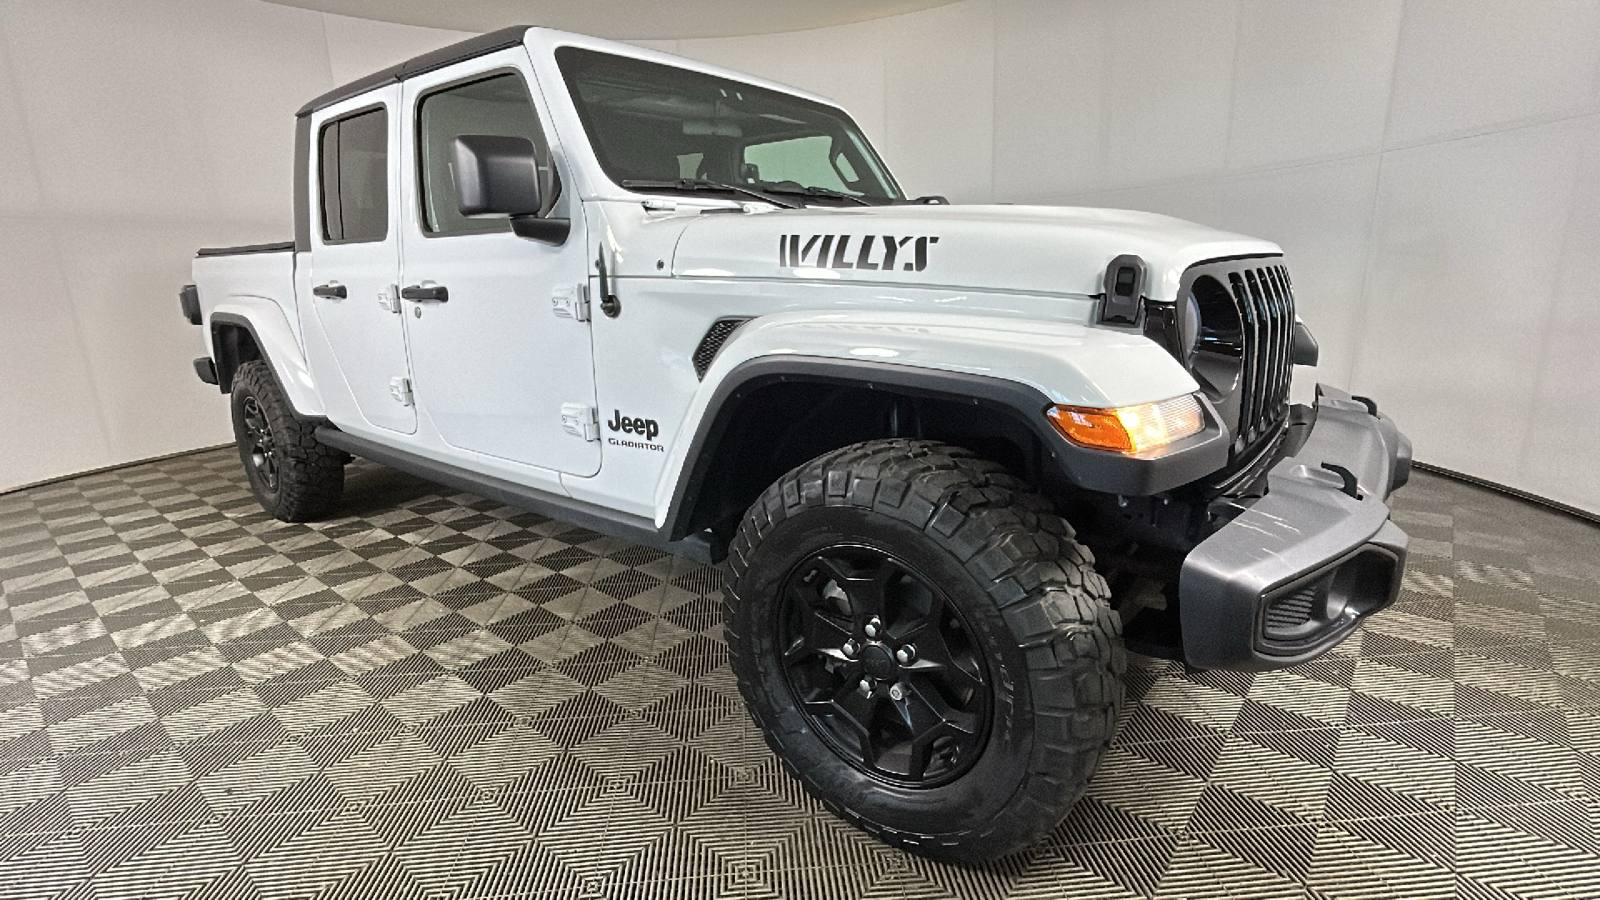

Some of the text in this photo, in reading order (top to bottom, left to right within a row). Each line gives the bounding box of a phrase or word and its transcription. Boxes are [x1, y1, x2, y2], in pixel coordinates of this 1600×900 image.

[779, 234, 940, 272] WILLYS
[607, 409, 659, 441] Jeep
[608, 437, 665, 452] GLADIATOR
